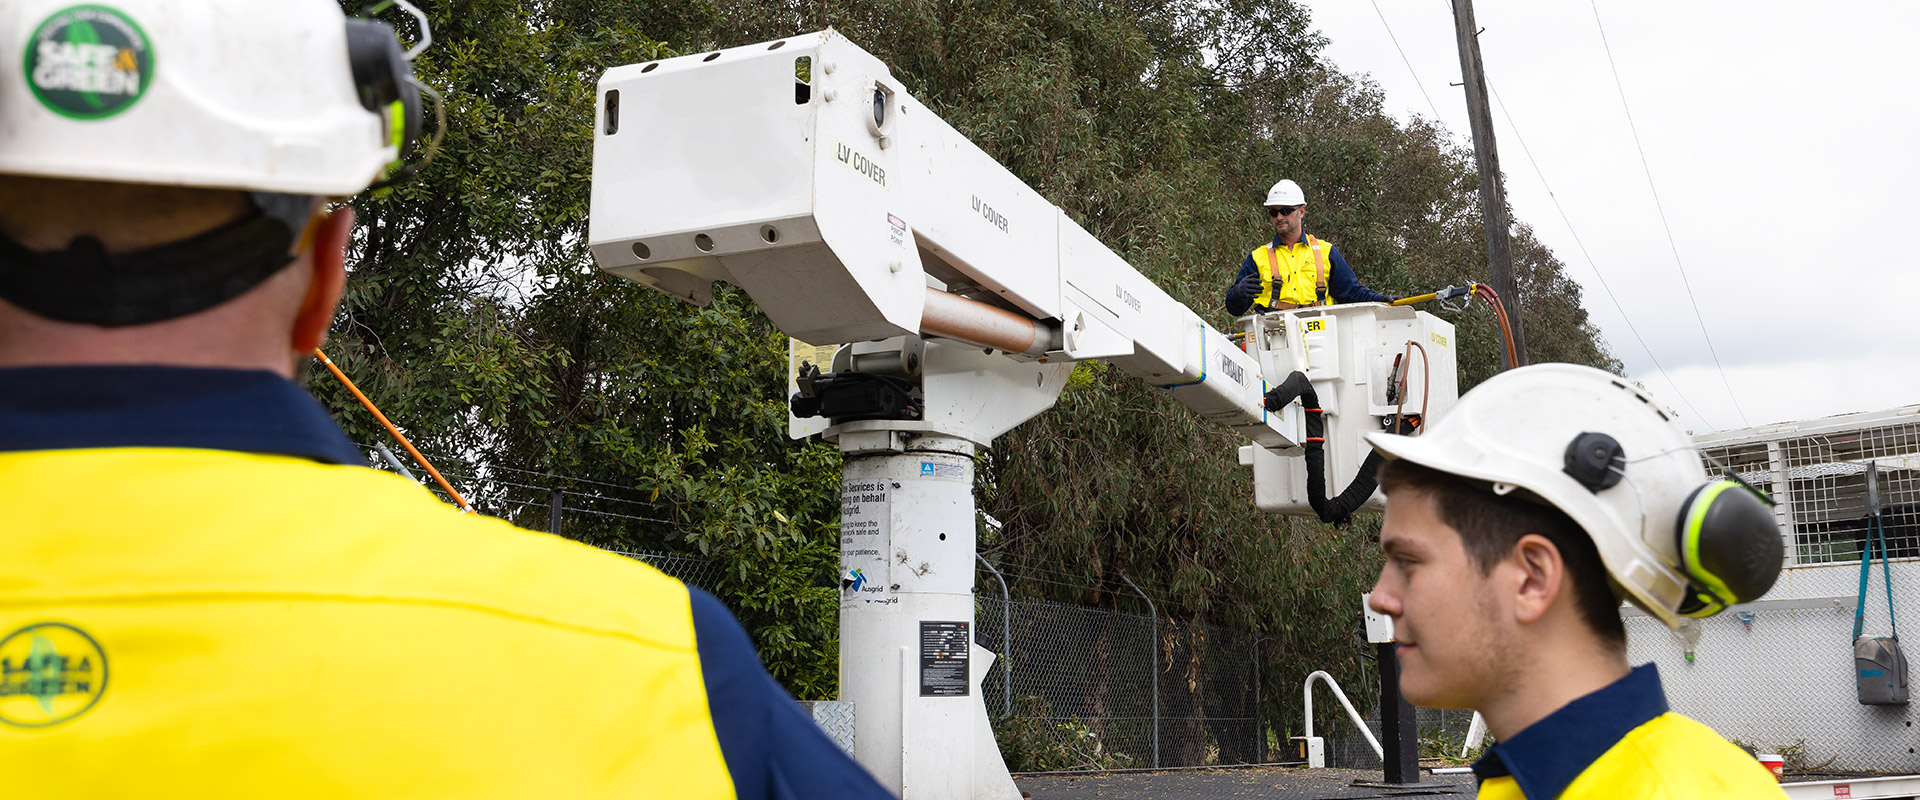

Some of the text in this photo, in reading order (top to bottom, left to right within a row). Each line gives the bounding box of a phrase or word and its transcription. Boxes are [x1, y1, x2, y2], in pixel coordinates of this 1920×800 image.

[837, 142, 886, 187] LV COVER
[971, 194, 1009, 234] LV COVER
[890, 234, 904, 247] POINT
[1115, 284, 1142, 314] LV COVER
[1221, 352, 1244, 387] VERSALIFT
[848, 482, 875, 494] Services
[877, 481, 885, 491] is
[853, 495, 861, 503] on
[861, 493, 886, 503] behalf
[855, 520, 868, 529] keep
[868, 519, 878, 527] the
[856, 528, 867, 536] safe
[868, 528, 880, 536] and
[855, 548, 880, 558] patience.
[861, 585, 884, 594] Ausgrid
